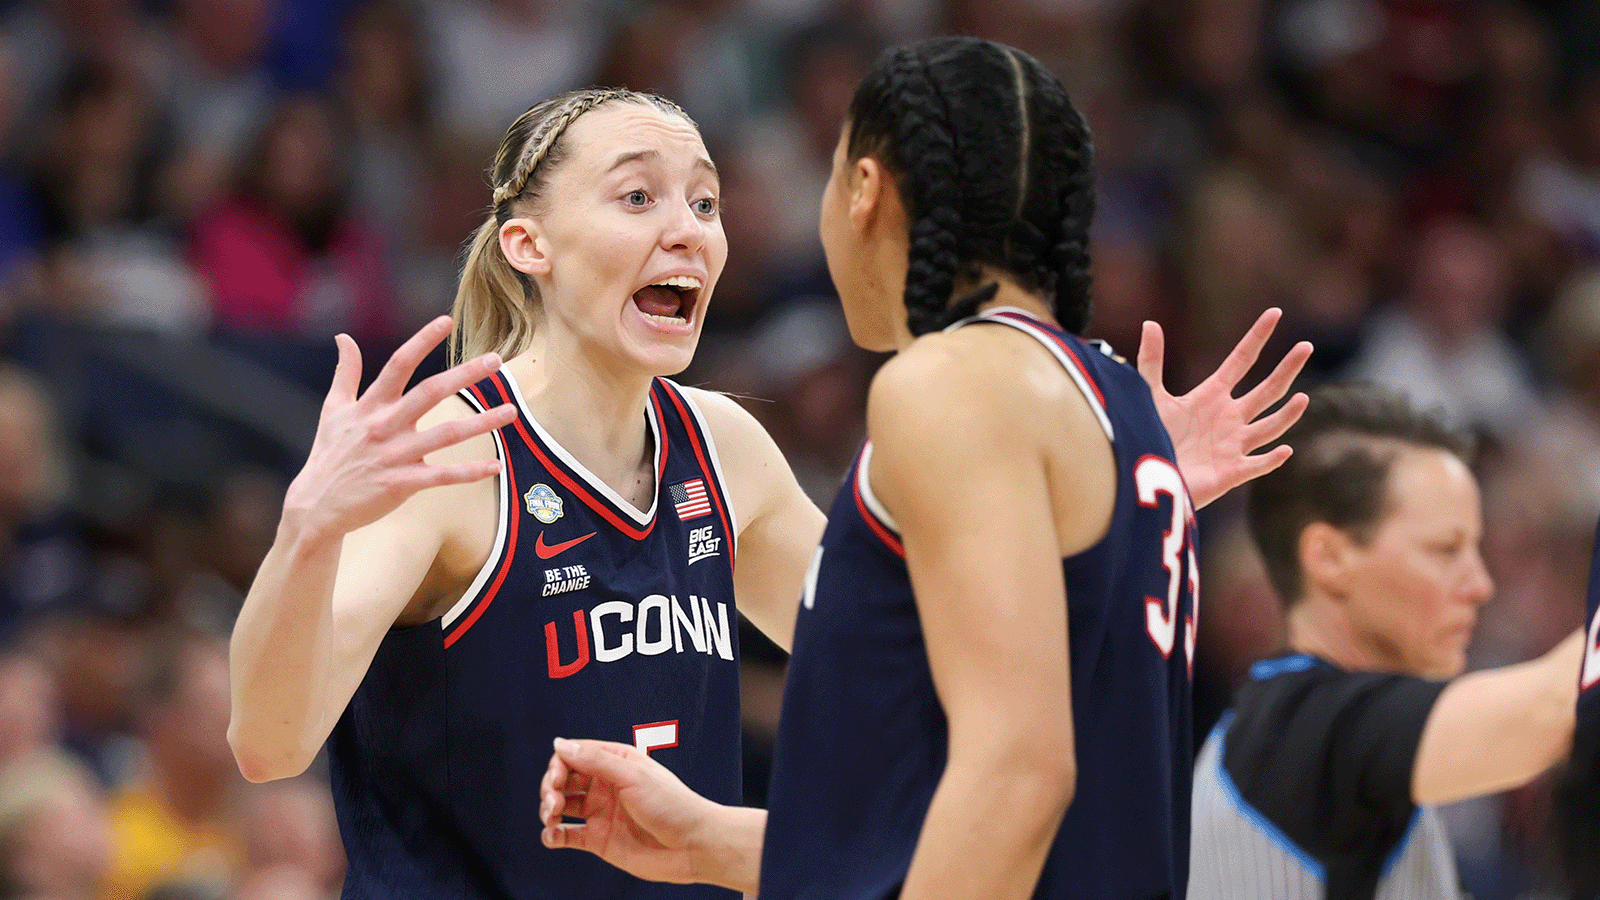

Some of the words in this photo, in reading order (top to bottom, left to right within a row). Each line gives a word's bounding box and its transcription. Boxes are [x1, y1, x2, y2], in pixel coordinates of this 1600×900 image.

[689, 525, 713, 544] BIG
[688, 537, 722, 558] EAST
[544, 569, 562, 583] BE
[562, 564, 588, 578] THE
[542, 575, 591, 597] CHANGE
[544, 594, 734, 679] UCONN
